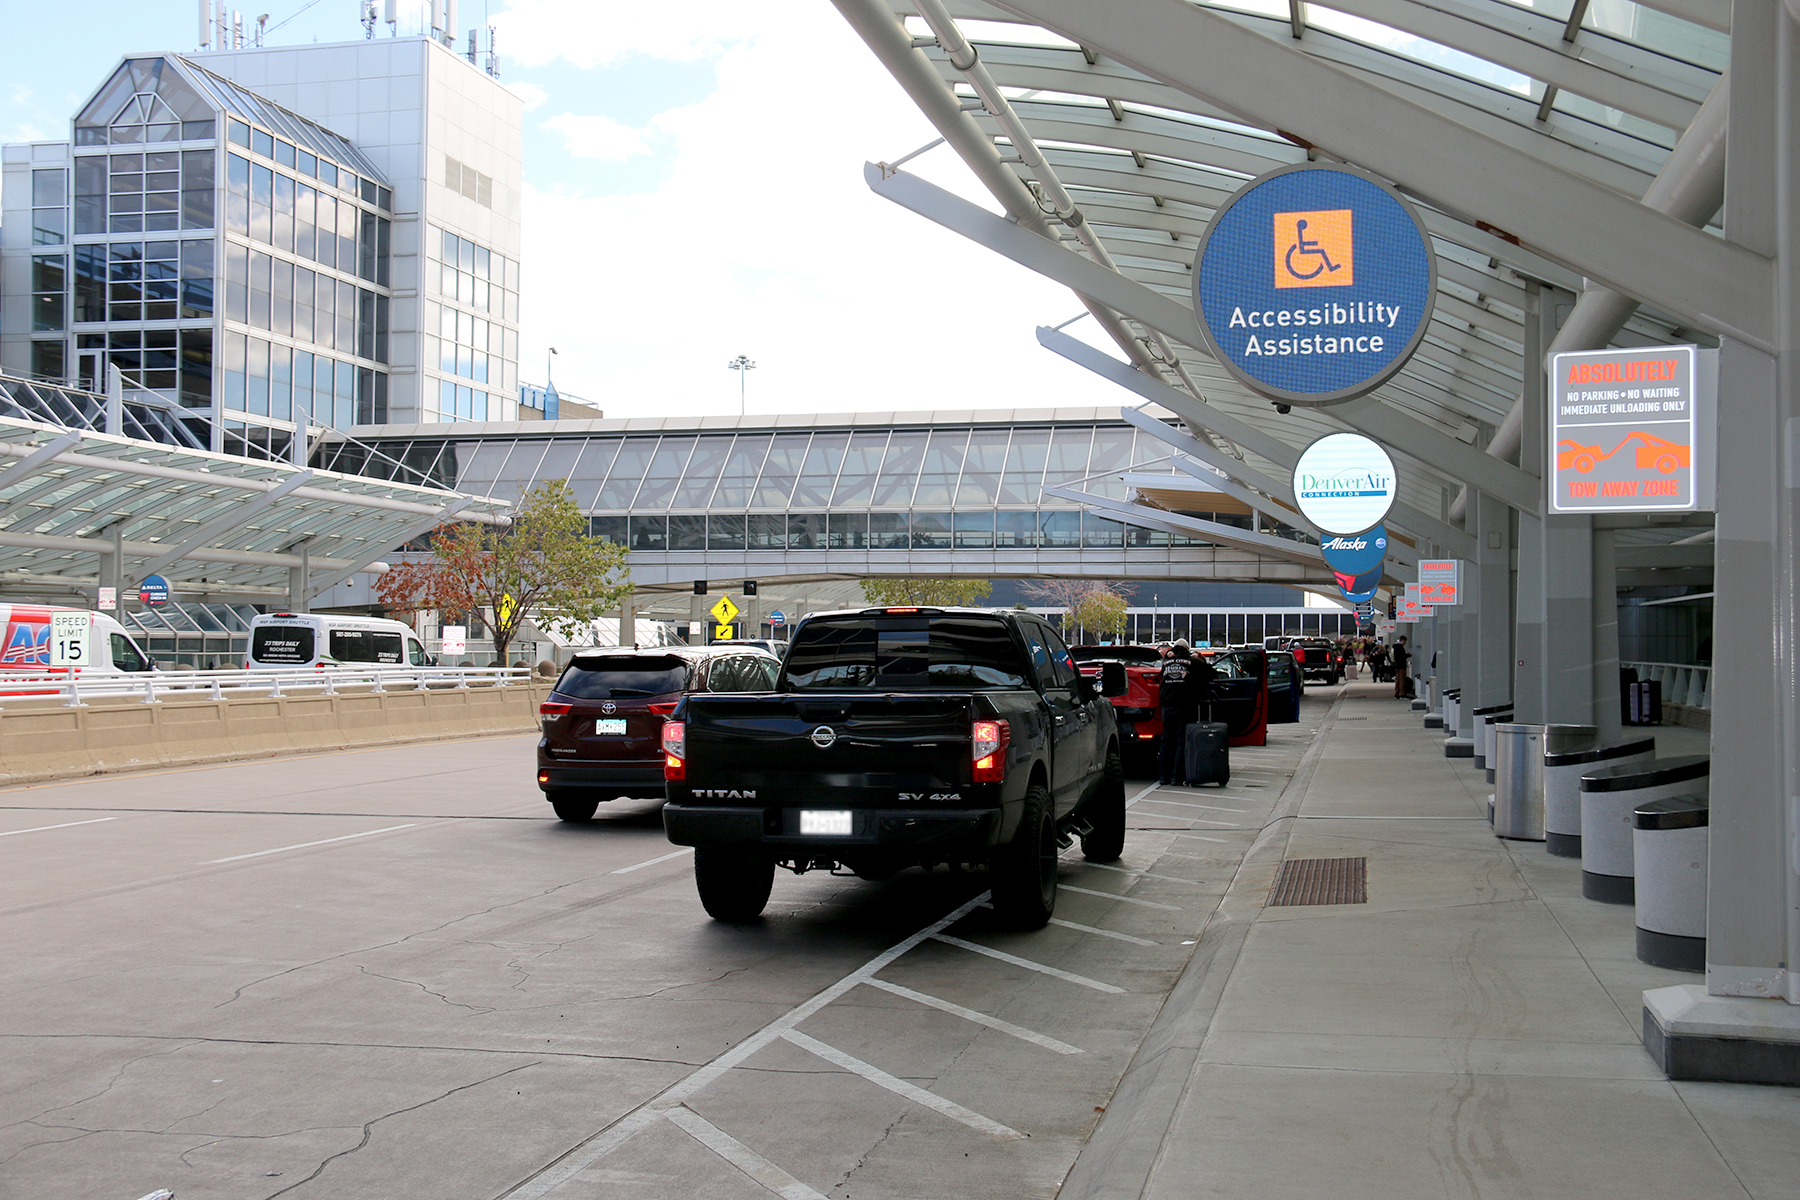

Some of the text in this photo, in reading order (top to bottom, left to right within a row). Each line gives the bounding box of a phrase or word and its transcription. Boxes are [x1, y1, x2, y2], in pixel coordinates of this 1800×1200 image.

[1228, 301, 1400, 328] Accessibility
[1245, 333, 1384, 357] Assistance
[1567, 359, 1678, 384] ABSOLUTELY
[1567, 387, 1680, 402] NO PARKING NO WAITING
[1561, 401, 1686, 416] IMMEDIATE UNLOADING ONLY
[1567, 479, 1680, 498] TOW AWAY ZONE
[1322, 537, 1368, 551] Alaska
[55, 617, 88, 626] SPEED
[58, 629, 83, 637] LIMIT
[59, 640, 82, 660] 15
[691, 789, 757, 799] TITAN
[898, 792, 924, 801] SV
